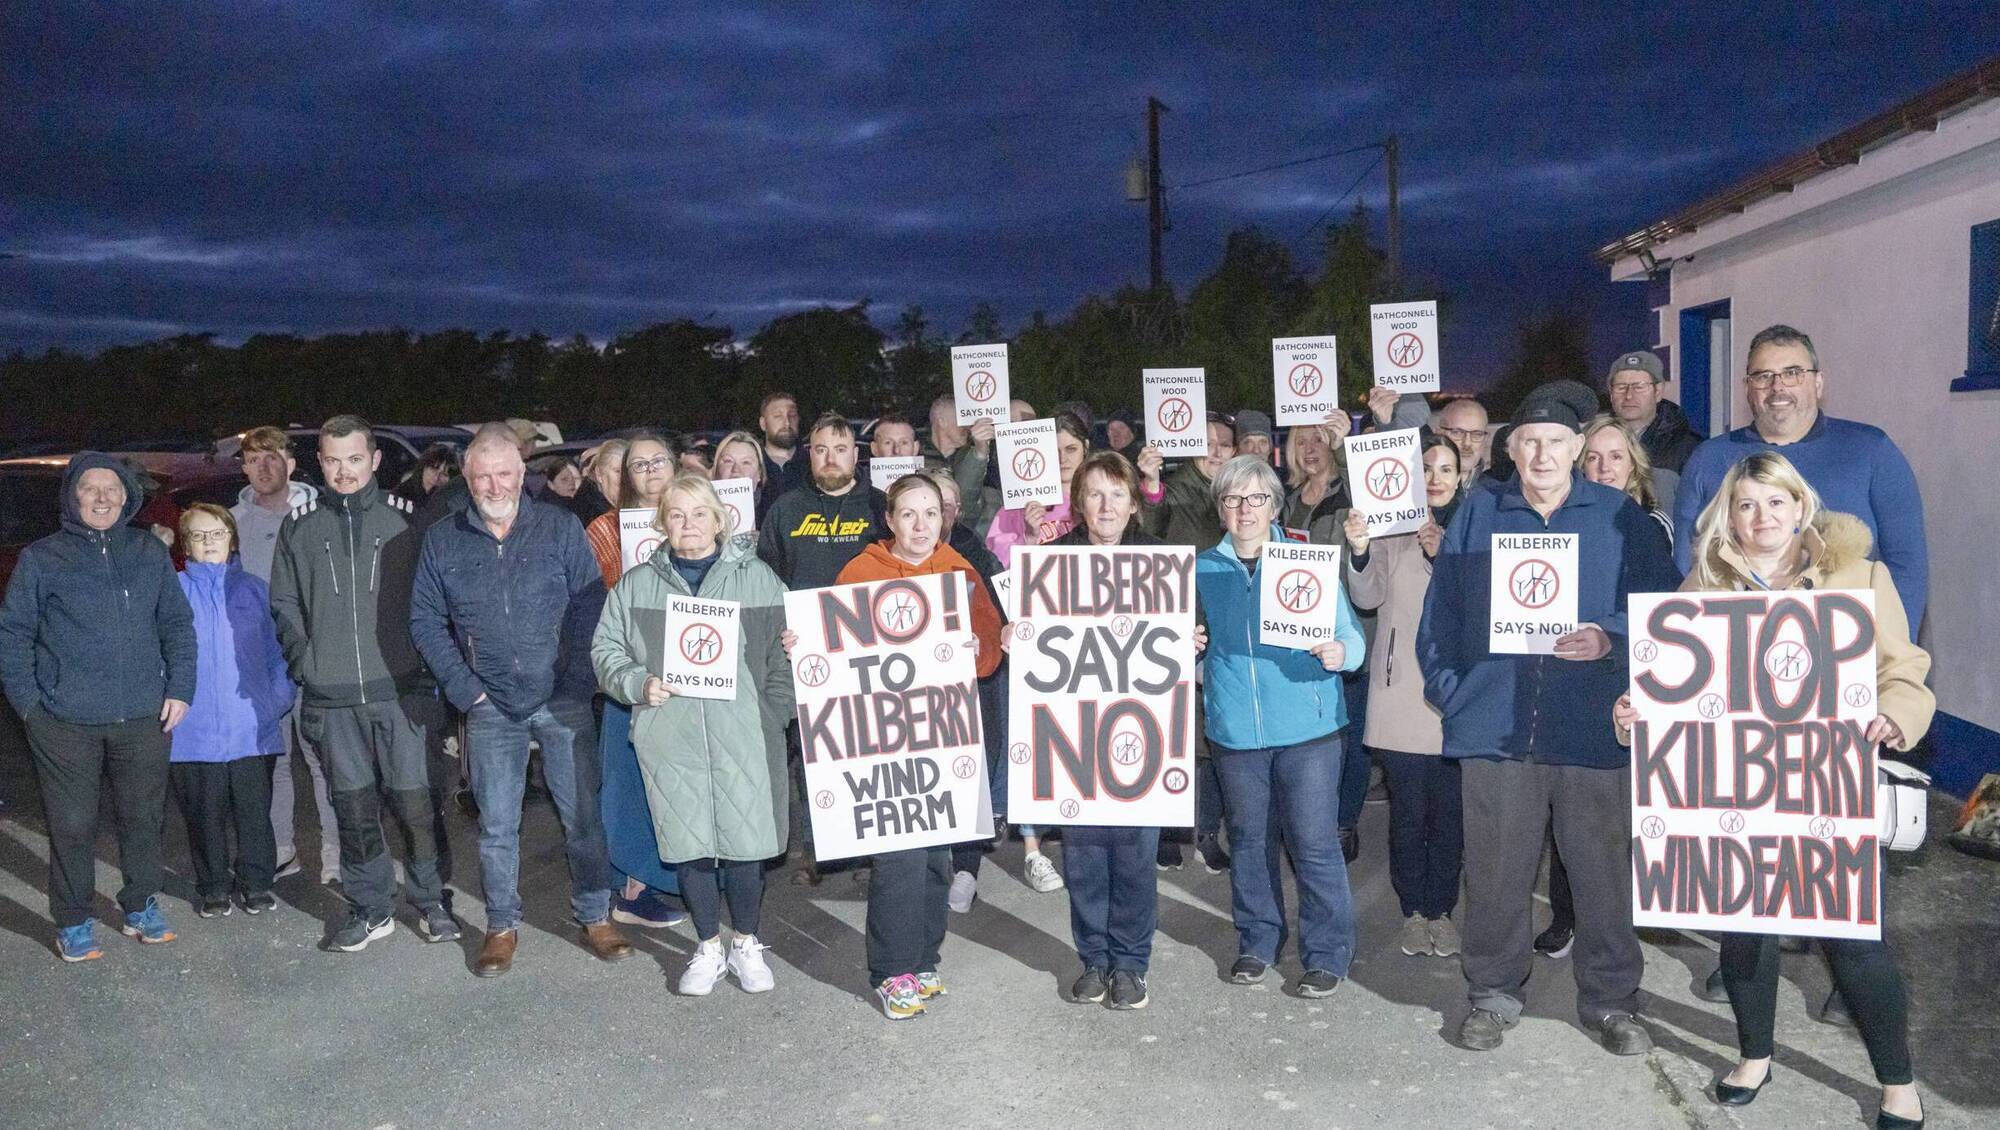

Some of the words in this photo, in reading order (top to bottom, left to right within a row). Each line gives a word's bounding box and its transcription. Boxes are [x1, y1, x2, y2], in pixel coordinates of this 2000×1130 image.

[1373, 309, 1435, 320] RATHCONNELL
[1390, 322, 1418, 330] WOOD
[1275, 341, 1334, 351] RATHCONNELL
[953, 351, 1006, 360] RATHCONNELL
[1292, 353, 1318, 361] WOOD
[968, 361, 992, 369] WOOD
[1145, 376, 1203, 384] RATHCONNELL
[1379, 375, 1408, 385] SAYS
[1410, 373, 1434, 384] NO!!
[1161, 387, 1187, 395] WOOD
[960, 408, 983, 418] SAYS
[985, 407, 1006, 416] NO!!
[1280, 403, 1308, 414] SAYS
[1310, 402, 1333, 412] NO!!
[997, 425, 1054, 437] RATHCONNELL
[1014, 437, 1039, 446] WOOD
[1150, 439, 1177, 448] SAYS
[1180, 438, 1203, 447] NO!!
[1351, 434, 1415, 454] KILBERRY
[717, 486, 750, 496] EYGATH
[1007, 488, 1033, 499] SAYS
[1035, 485, 1057, 496] NO!!
[1366, 512, 1393, 526] AYS
[1396, 507, 1426, 521] NO!!
[1498, 537, 1571, 549] KILBERRY
[1268, 547, 1335, 562] KILBERRY
[1020, 552, 1194, 618] KILBERRY
[672, 601, 735, 618] KILBERRY
[1263, 620, 1298, 635] SAYS
[1301, 624, 1331, 639] NO!!
[1494, 621, 1534, 635] SAYS
[1539, 622, 1573, 635] NO!!
[1023, 620, 1182, 696] SAYS
[1634, 592, 1876, 724] STOP
[666, 673, 700, 686] SAYS
[704, 676, 733, 688] NO!!
[849, 652, 916, 695] TO
[797, 678, 981, 764] KILBERRY
[1633, 719, 1877, 819] KILBERRY
[843, 757, 941, 803] WIND
[853, 790, 957, 840] FARM
[1632, 834, 1878, 926] WINDFARM
